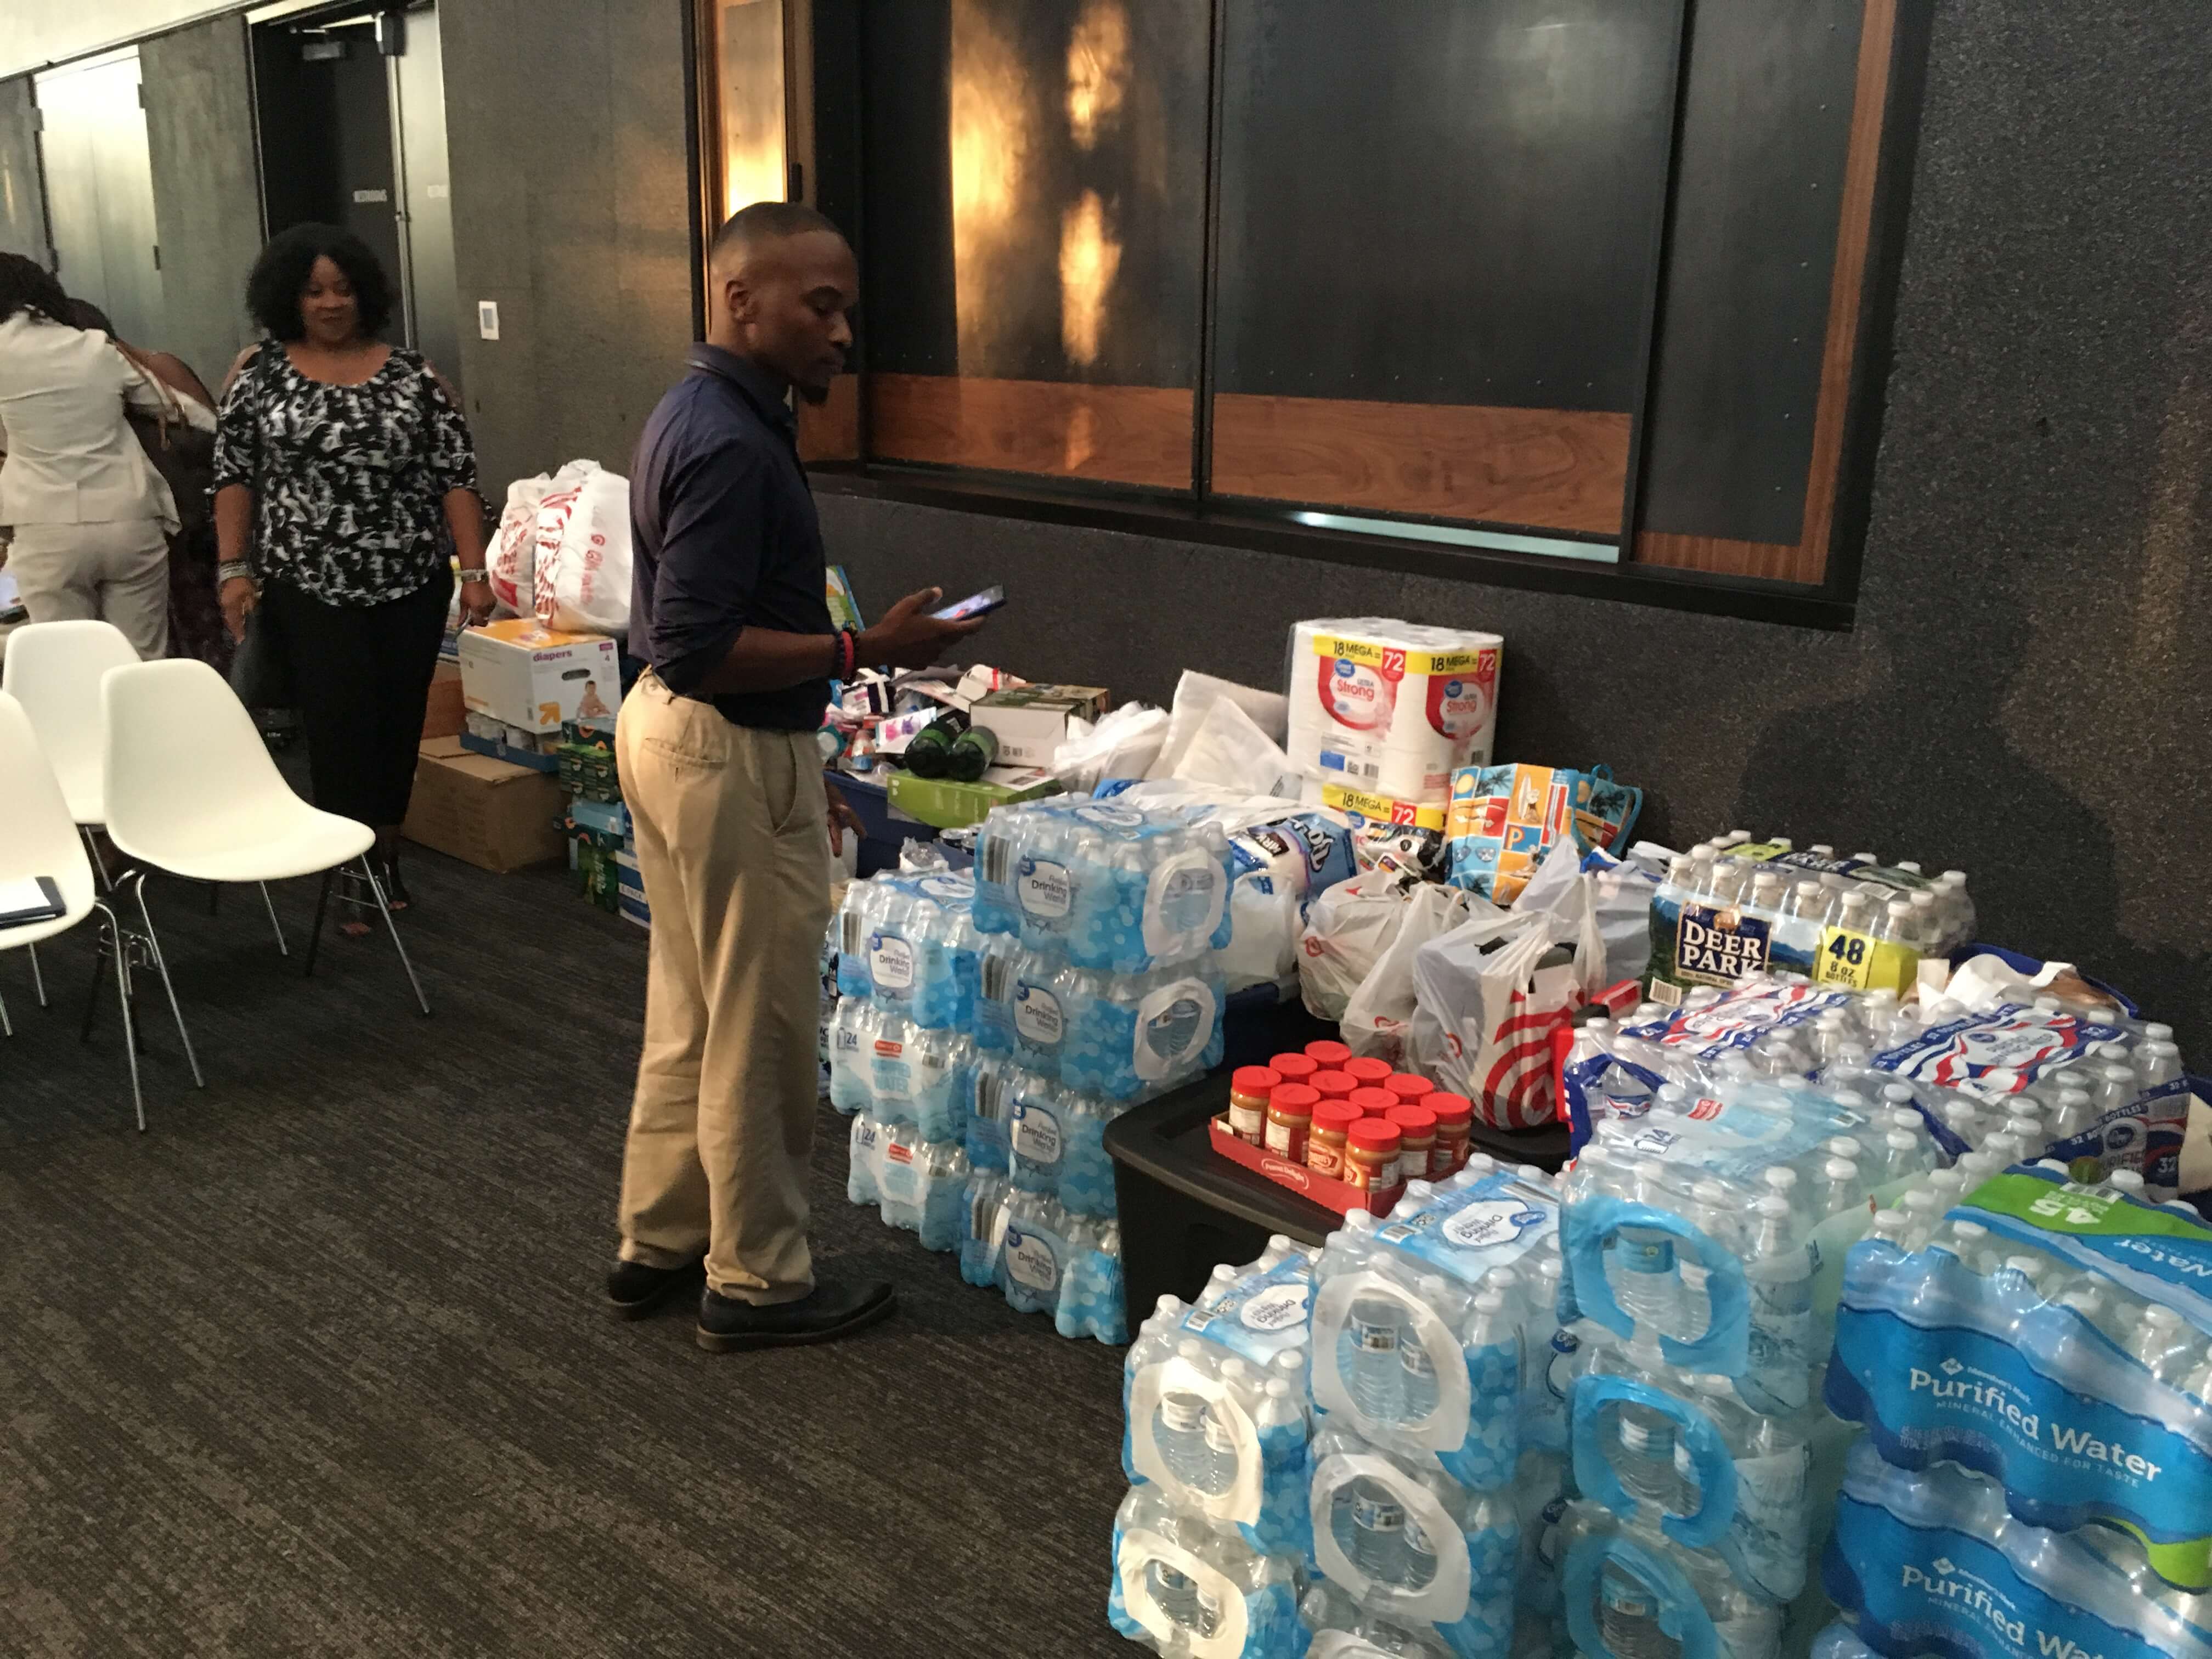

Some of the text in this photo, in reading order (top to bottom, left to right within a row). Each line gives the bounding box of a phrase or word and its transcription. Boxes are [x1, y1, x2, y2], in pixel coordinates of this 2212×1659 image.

[533, 650, 572, 662] diapers
[1334, 641, 1404, 672] 18 MEGA 72
[1431, 653, 1496, 673] 18 MEGA 72
[1337, 679, 1375, 702] Strong
[1342, 792, 1414, 826] 18 MEGA 72
[1031, 879, 1067, 898] Drinking
[1683, 918, 1763, 960] DEER
[1828, 934, 1865, 966] 48
[879, 954, 910, 972] Drinking
[1681, 944, 1762, 978] PARK
[1830, 961, 1838, 972] 8
[1825, 970, 1857, 988] BOTTLES
[1025, 1005, 1058, 1027] Drinking
[847, 1032, 857, 1046] 24
[864, 1128, 876, 1143] 24
[1022, 1123, 1056, 1147] Drinking
[2069, 1135, 2085, 1146] 32
[2157, 1156, 2178, 1174] 32
[1018, 1251, 1052, 1276] Drinking
[1910, 1367, 2040, 1441] Purified
[2051, 1423, 2162, 1482] Water
[1936, 1400, 1995, 1422] MINERAL
[1999, 1419, 2059, 1463] ENHANCED
[2063, 1457, 2091, 1470] FOR
[2096, 1464, 2140, 1489] TASTE
[1901, 1564, 2025, 1646] Purified
[1927, 1596, 1981, 1624] MINERAL
